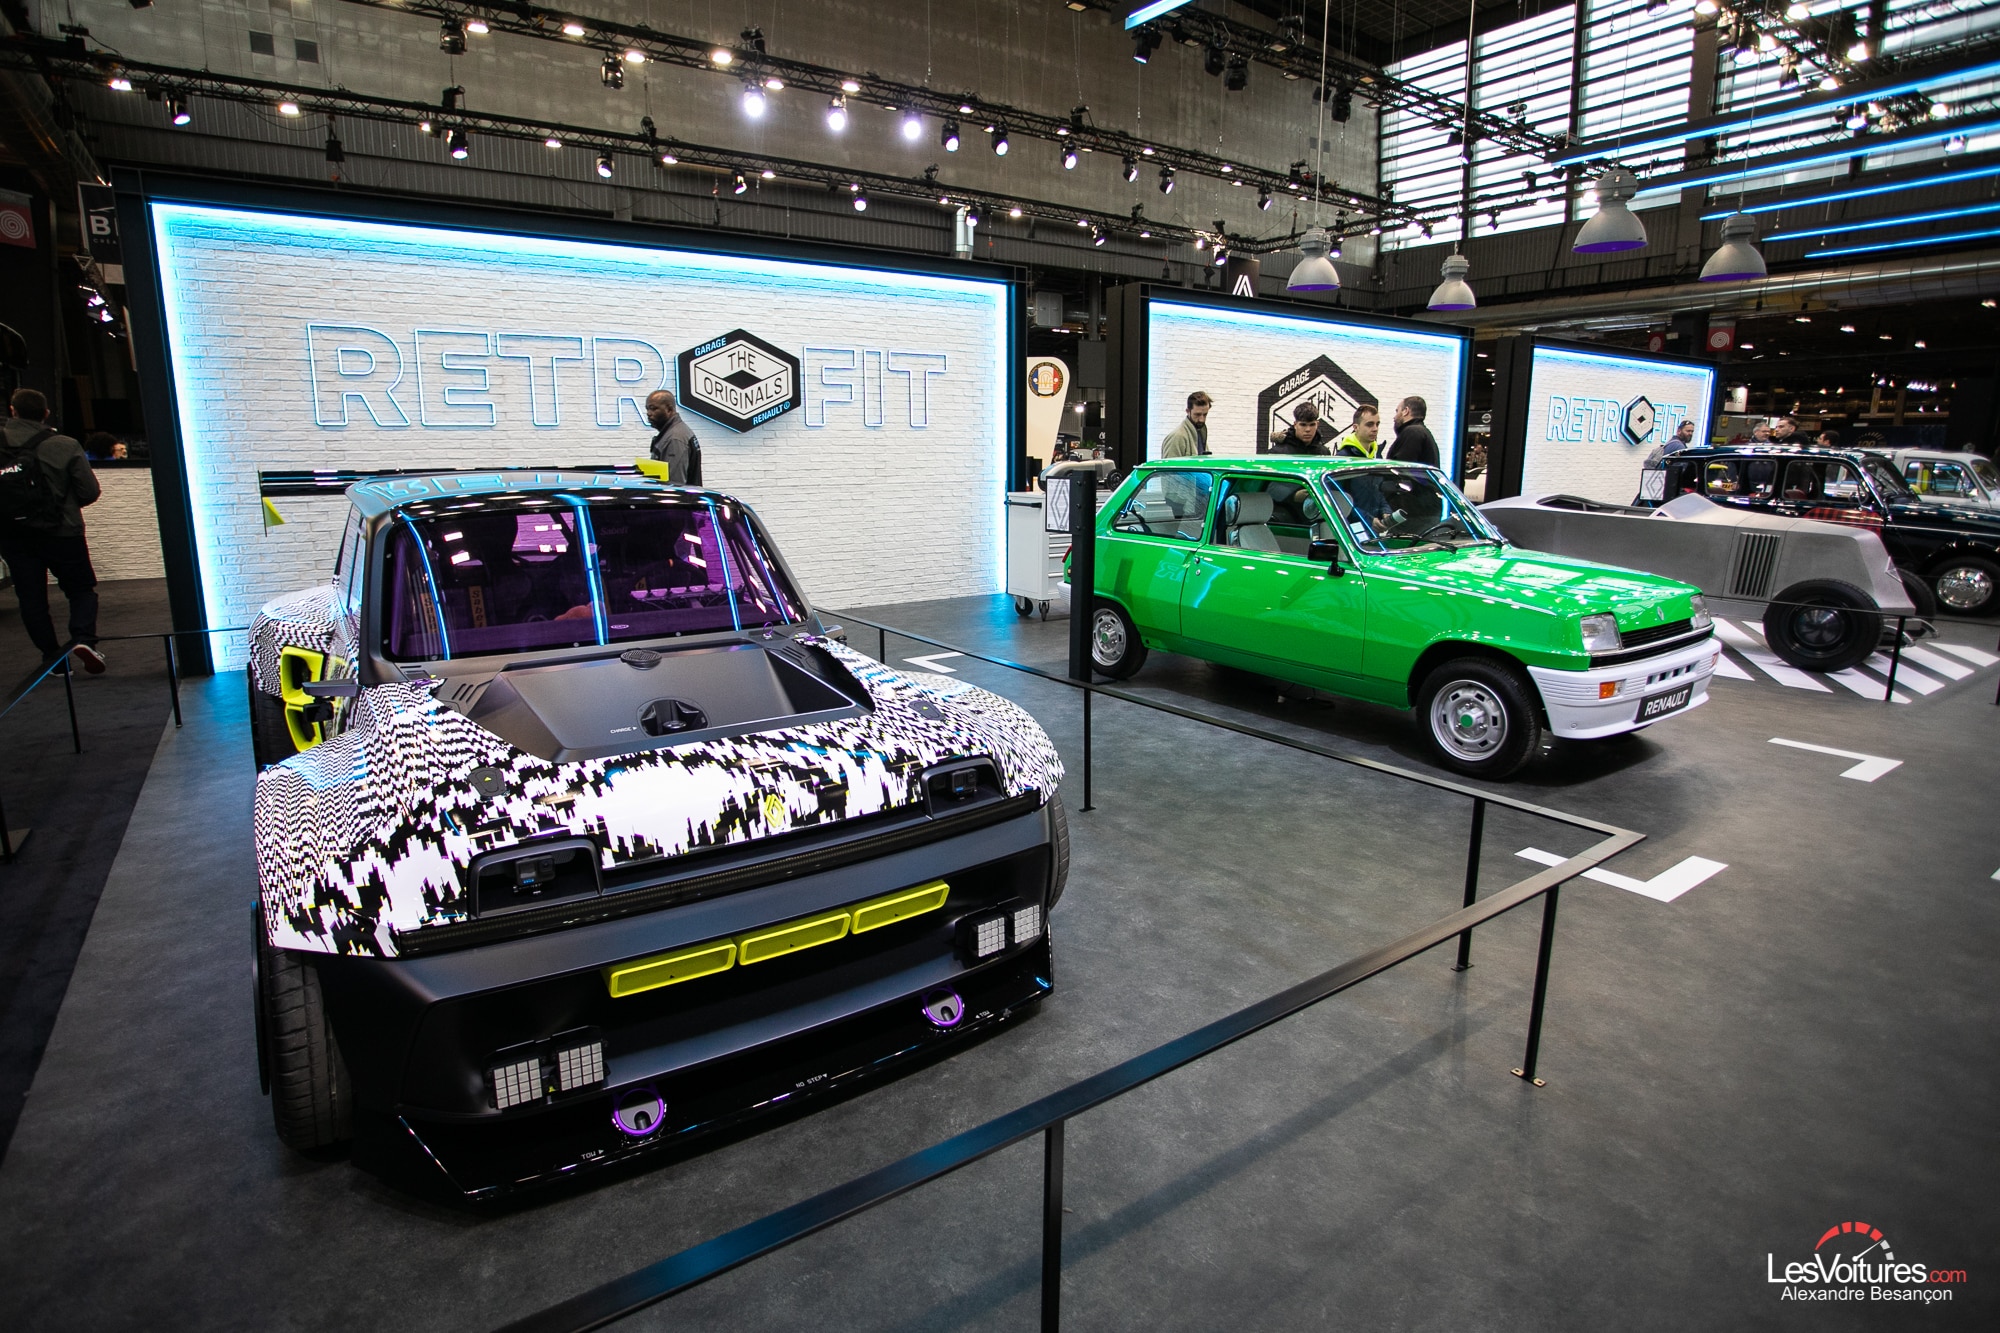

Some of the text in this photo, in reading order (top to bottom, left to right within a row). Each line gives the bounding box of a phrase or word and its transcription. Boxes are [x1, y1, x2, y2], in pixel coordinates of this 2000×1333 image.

[694, 337, 727, 357] GARAGE
[727, 350, 756, 373] THE
[703, 376, 783, 410] ORIGINALS
[1278, 368, 1311, 397] GARAGE
[752, 403, 784, 426] RENAULT
[1307, 390, 1336, 422] THE
[1644, 689, 1689, 716] RENAULT
[610, 726, 632, 734] CHARGE
[806, 1074, 823, 1085] STEP
